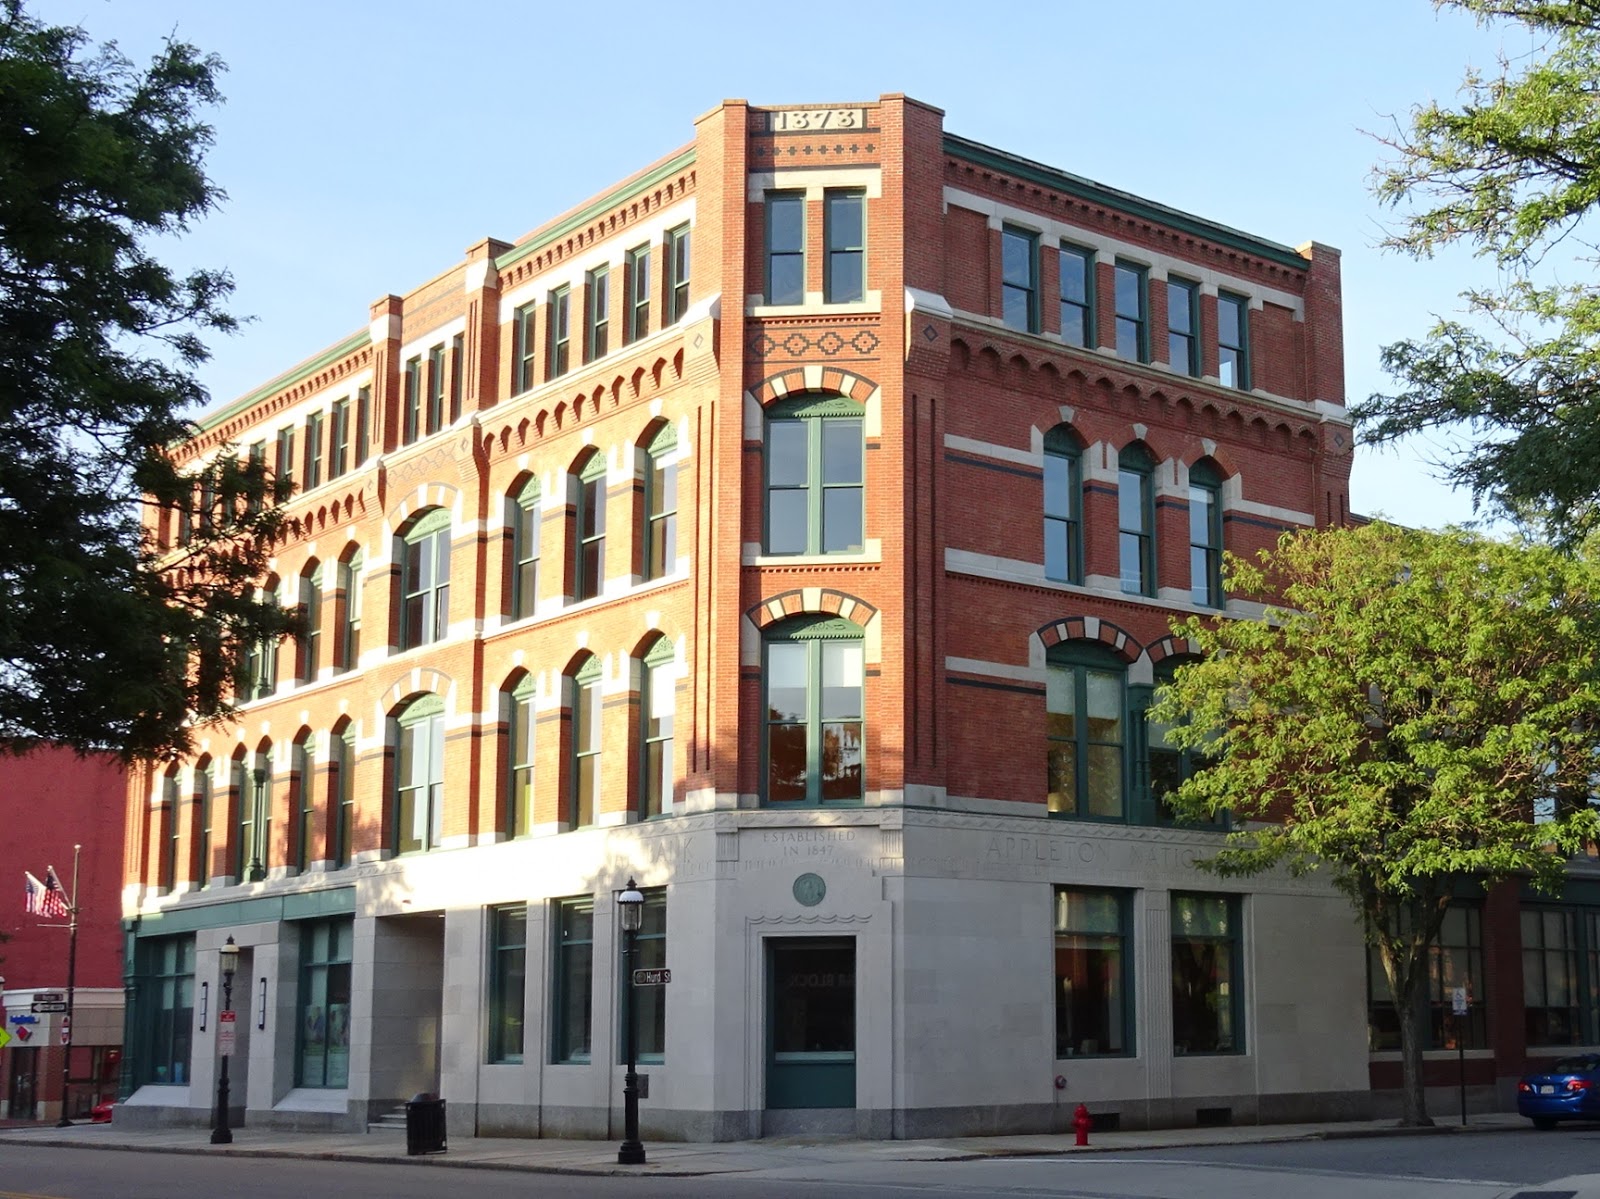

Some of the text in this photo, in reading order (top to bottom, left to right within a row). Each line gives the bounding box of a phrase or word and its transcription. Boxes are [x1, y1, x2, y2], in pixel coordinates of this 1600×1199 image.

[763, 830, 856, 842] ESTABLISHED
[643, 836, 694, 864] ANK
[783, 845, 834, 856] IN 1847
[986, 836, 1110, 863] APPLETON
[646, 971, 661, 983] Hurd
